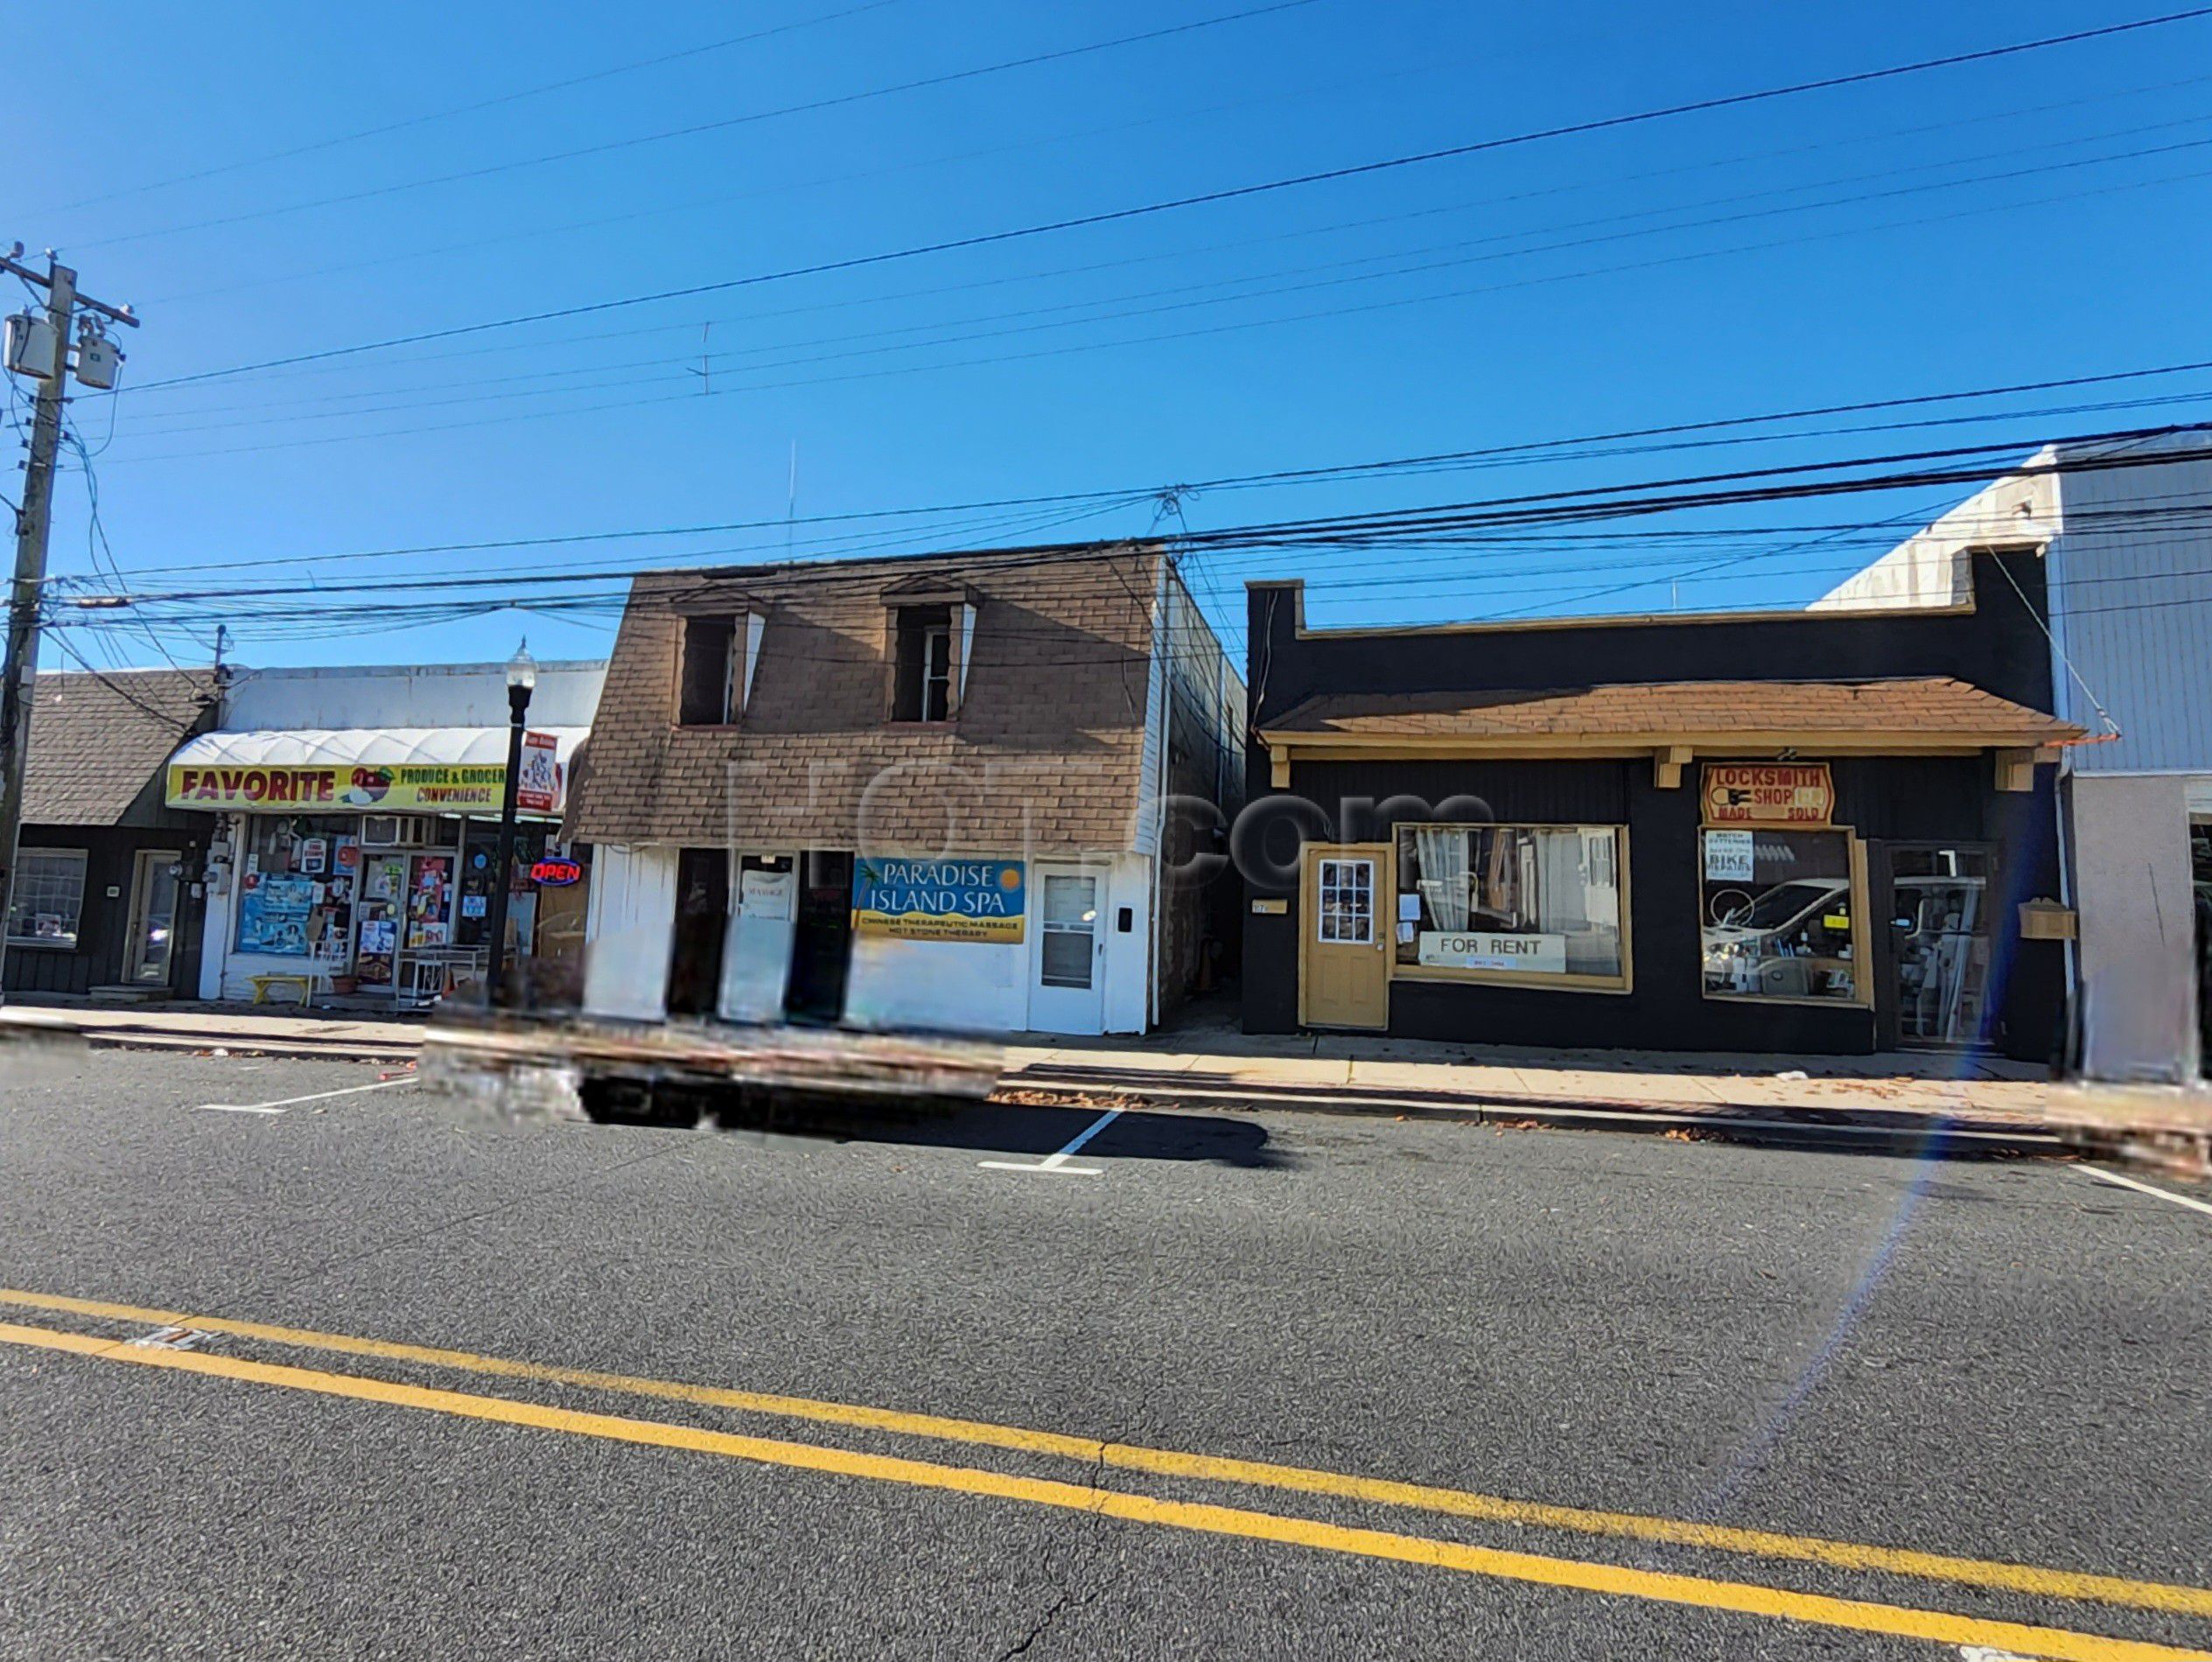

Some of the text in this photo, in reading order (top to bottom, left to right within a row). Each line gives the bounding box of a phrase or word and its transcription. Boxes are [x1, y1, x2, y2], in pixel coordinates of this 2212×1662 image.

[401, 768, 506, 784] PRODUCE & GROCER
[1716, 769, 1821, 787] LOCKSMITH
[181, 769, 336, 802] FAVORITE
[416, 786, 492, 803] CONVENIENCE
[1754, 789, 1792, 805] SHOP
[1788, 807, 1819, 821] SOLD
[1709, 855, 1749, 866] BIKE
[531, 864, 581, 880] OPEN
[884, 864, 993, 887] PARADISE
[871, 889, 1005, 914] ISLAND SPA
[862, 916, 1018, 930] CHINESE THERAPEUTIC MASSAGE
[1440, 938, 1542, 955] FOR RENT
